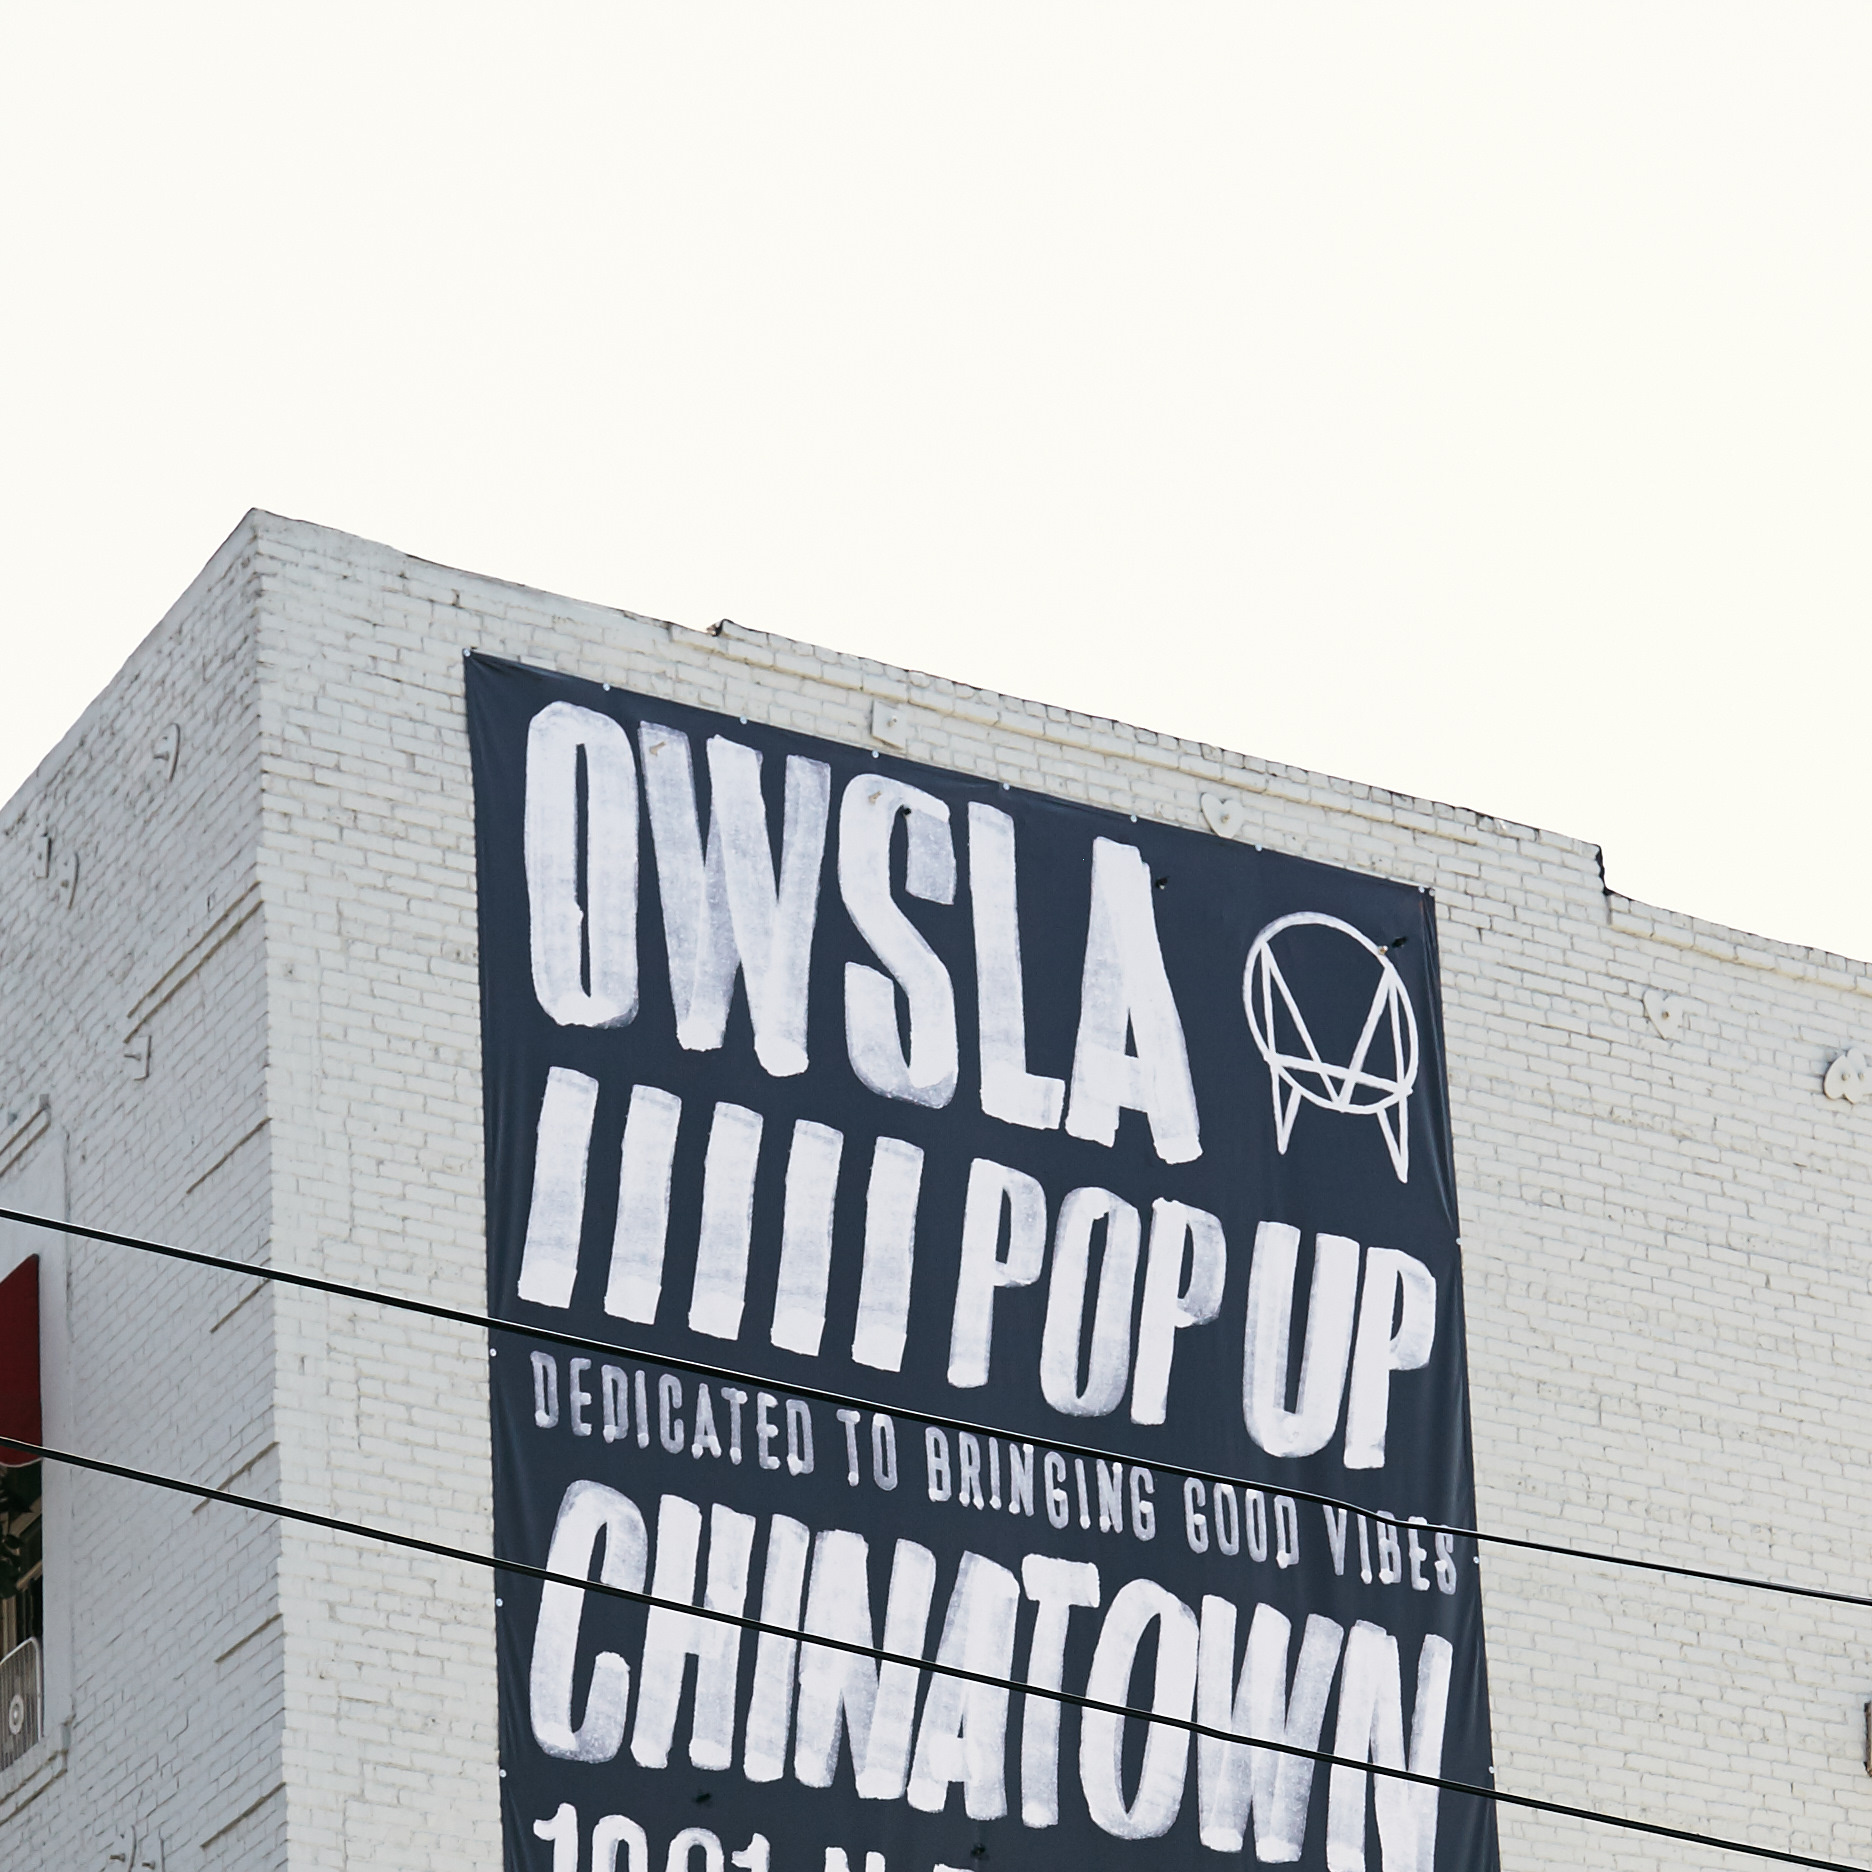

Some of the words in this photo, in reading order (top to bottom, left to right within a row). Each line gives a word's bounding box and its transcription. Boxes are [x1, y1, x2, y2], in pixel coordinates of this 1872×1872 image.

[525, 699, 1202, 1164] OWSLA
[947, 1157, 1227, 1426] POP
[1243, 1221, 1438, 1469] UP
[530, 1350, 816, 1476] DEDICATED
[836, 1408, 899, 1491] TO
[926, 1426, 1157, 1542] BRINGING
[1184, 1477, 1300, 1568] GOOD
[1323, 1503, 1459, 1595] VIBES
